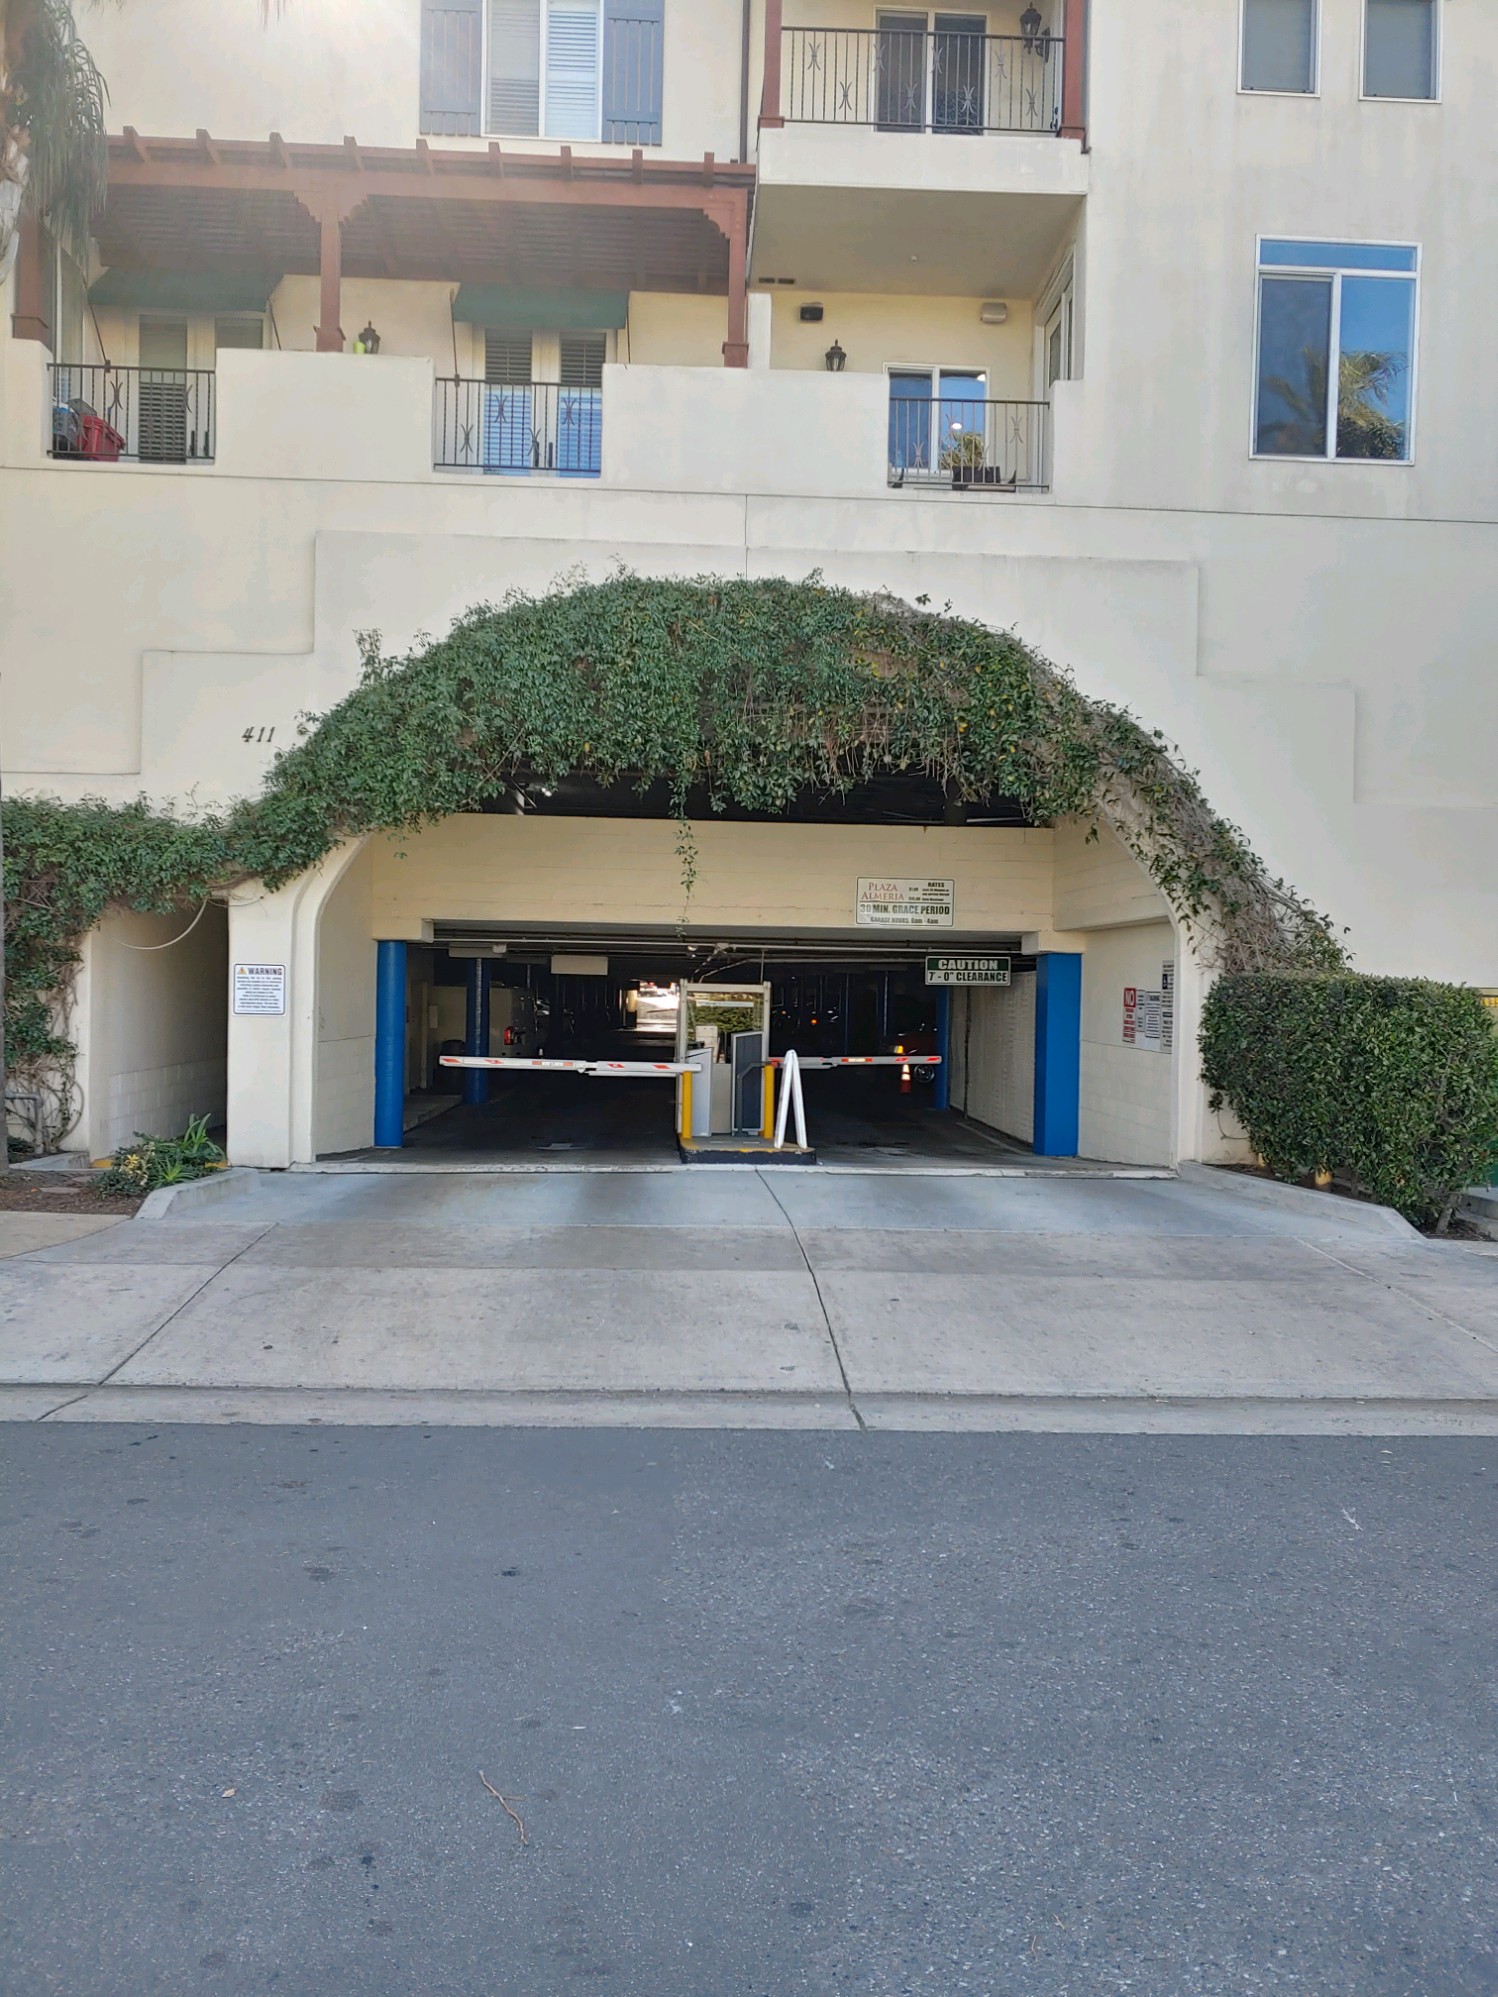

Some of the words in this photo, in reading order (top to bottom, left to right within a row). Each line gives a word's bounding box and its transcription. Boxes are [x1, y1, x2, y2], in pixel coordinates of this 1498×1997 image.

[241, 726, 275, 742] 411
[868, 882, 898, 892] PLAZA
[861, 891, 904, 901] ALMERIA
[860, 904, 872, 913] 30
[892, 904, 919, 914] GRACE
[920, 905, 950, 915] PERIOD
[938, 959, 998, 970] CAUTION
[247, 967, 283, 976] WARNING
[956, 972, 1007, 982] CLEARANCE
[1125, 989, 1135, 1007] NO
